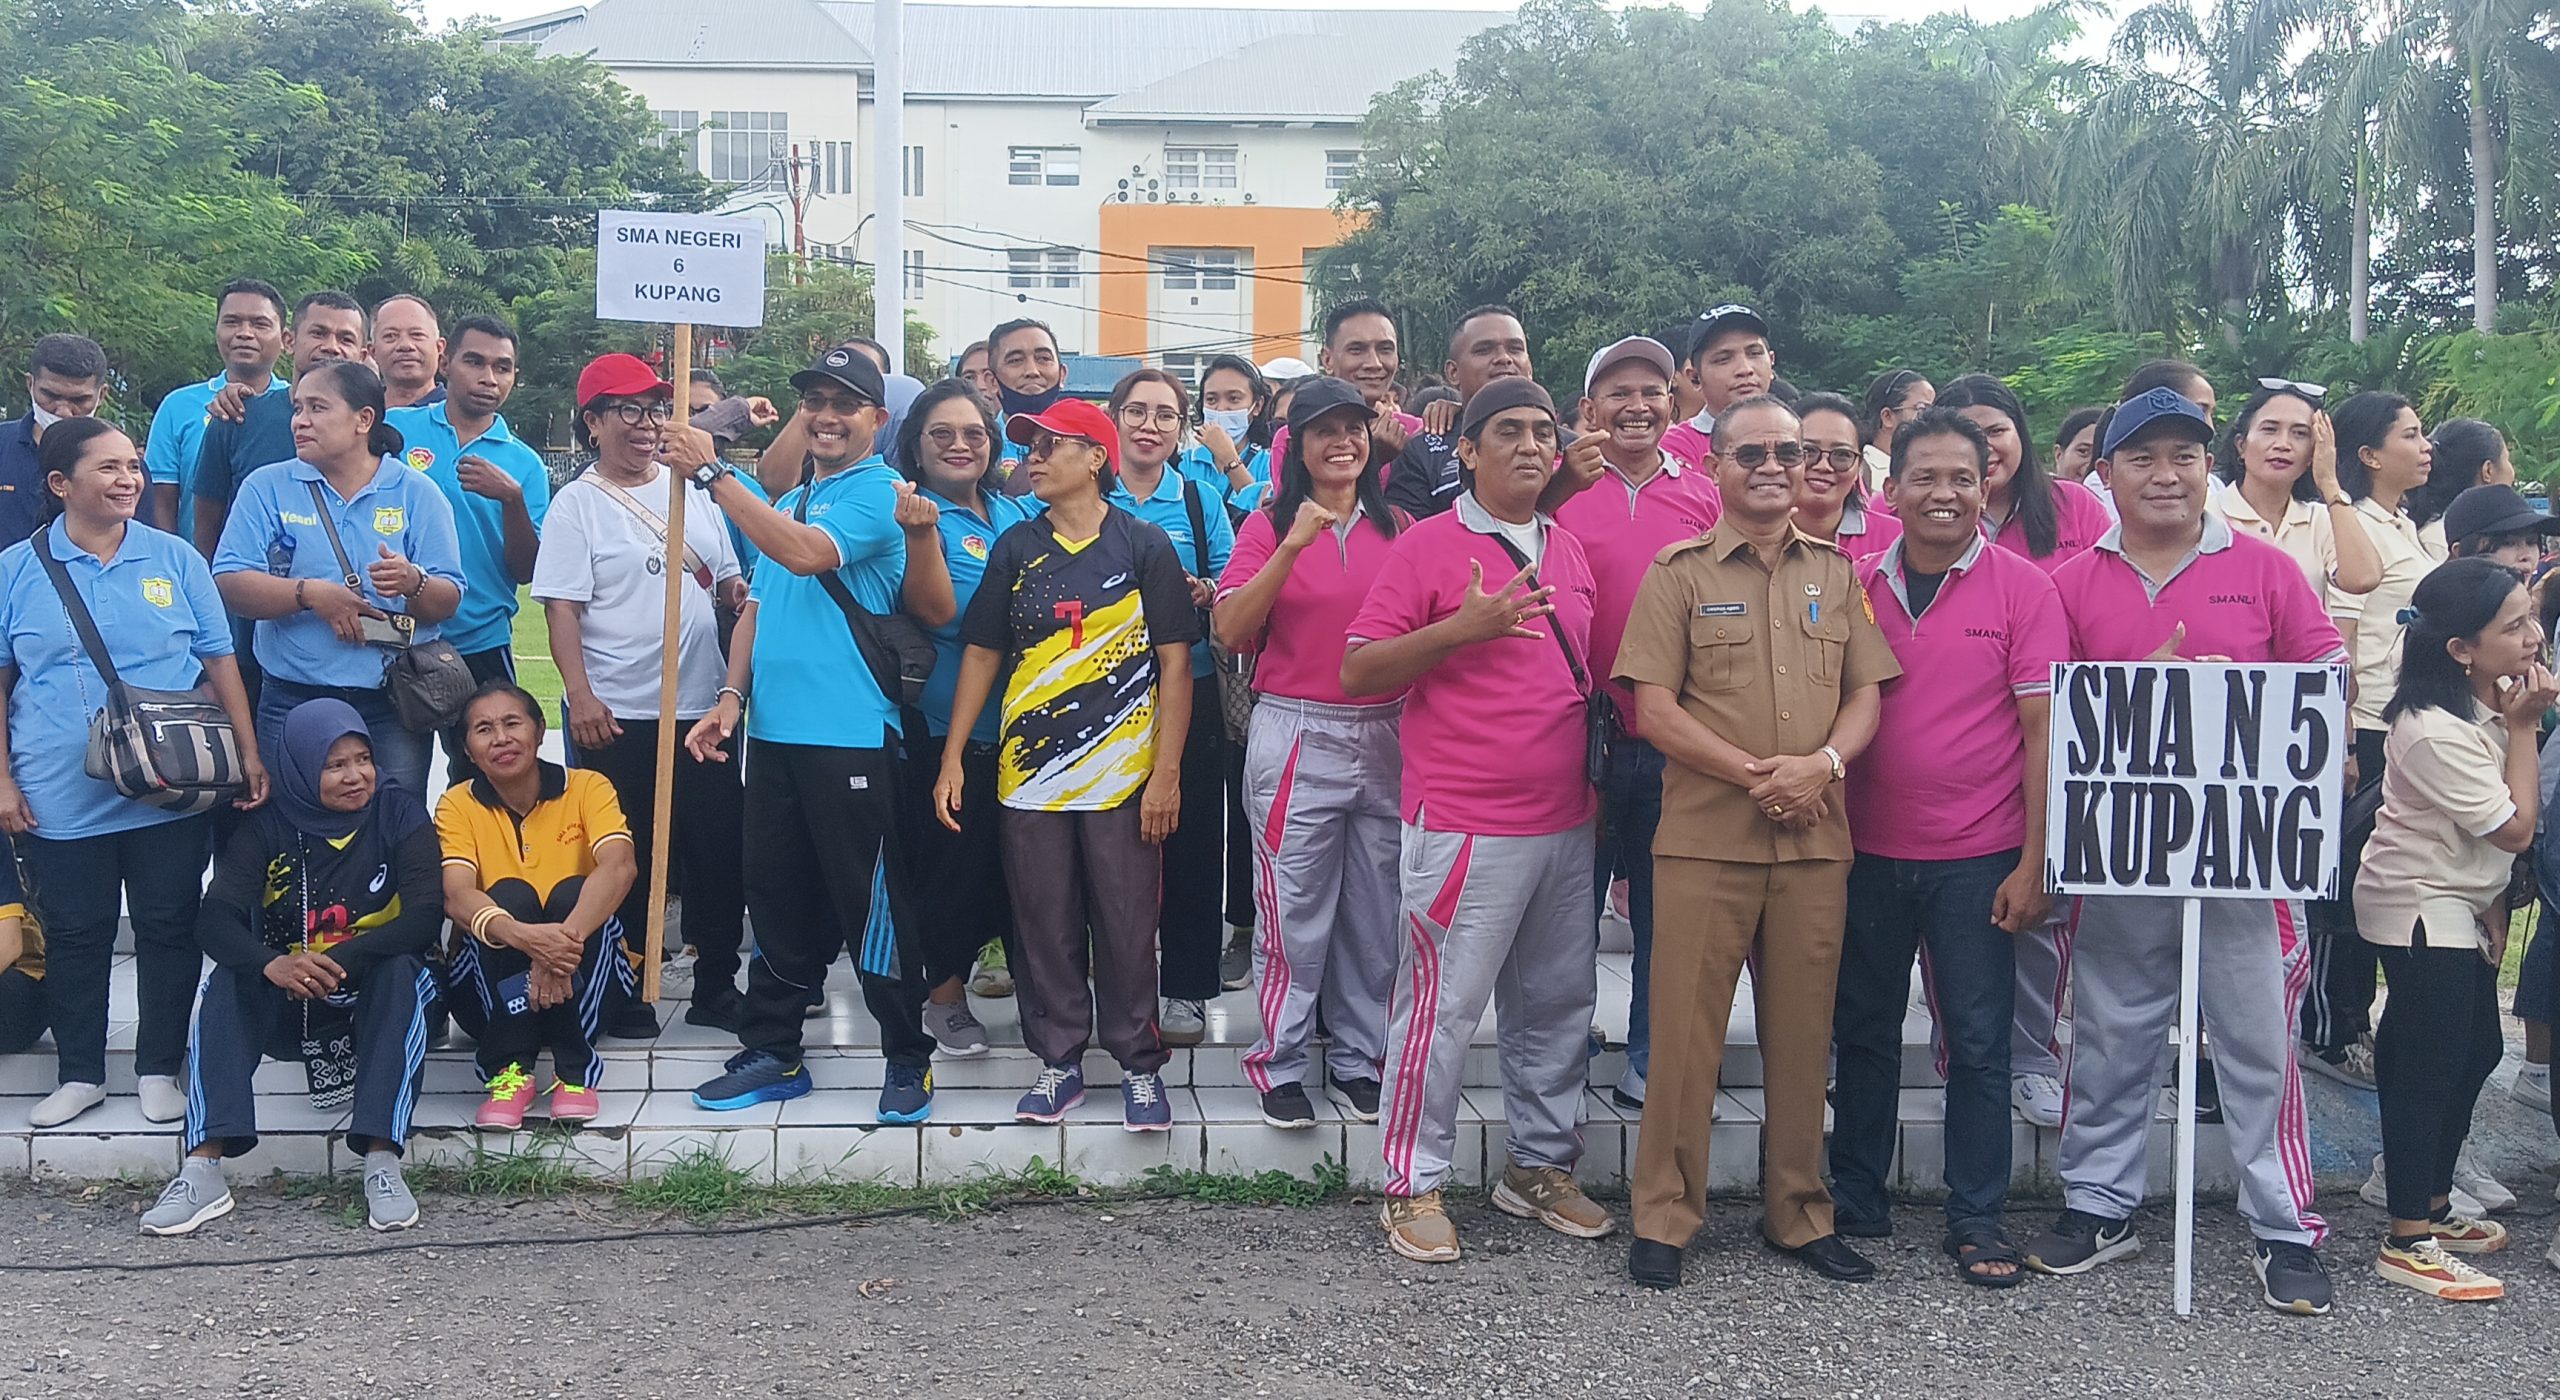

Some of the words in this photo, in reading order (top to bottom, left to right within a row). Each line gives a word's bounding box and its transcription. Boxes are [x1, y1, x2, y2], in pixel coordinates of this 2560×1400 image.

[616, 226, 660, 245] SMA
[665, 229, 741, 249] NEGERI
[673, 258, 685, 273] 6
[635, 283, 721, 303] KUPANG
[2208, 595, 2256, 605] SMANLI
[1054, 600, 1083, 650] 7
[2067, 664, 2198, 779] SMA
[2219, 669, 2267, 780] N
[2286, 669, 2330, 782] 5
[2060, 780, 2325, 893] KUPANG
